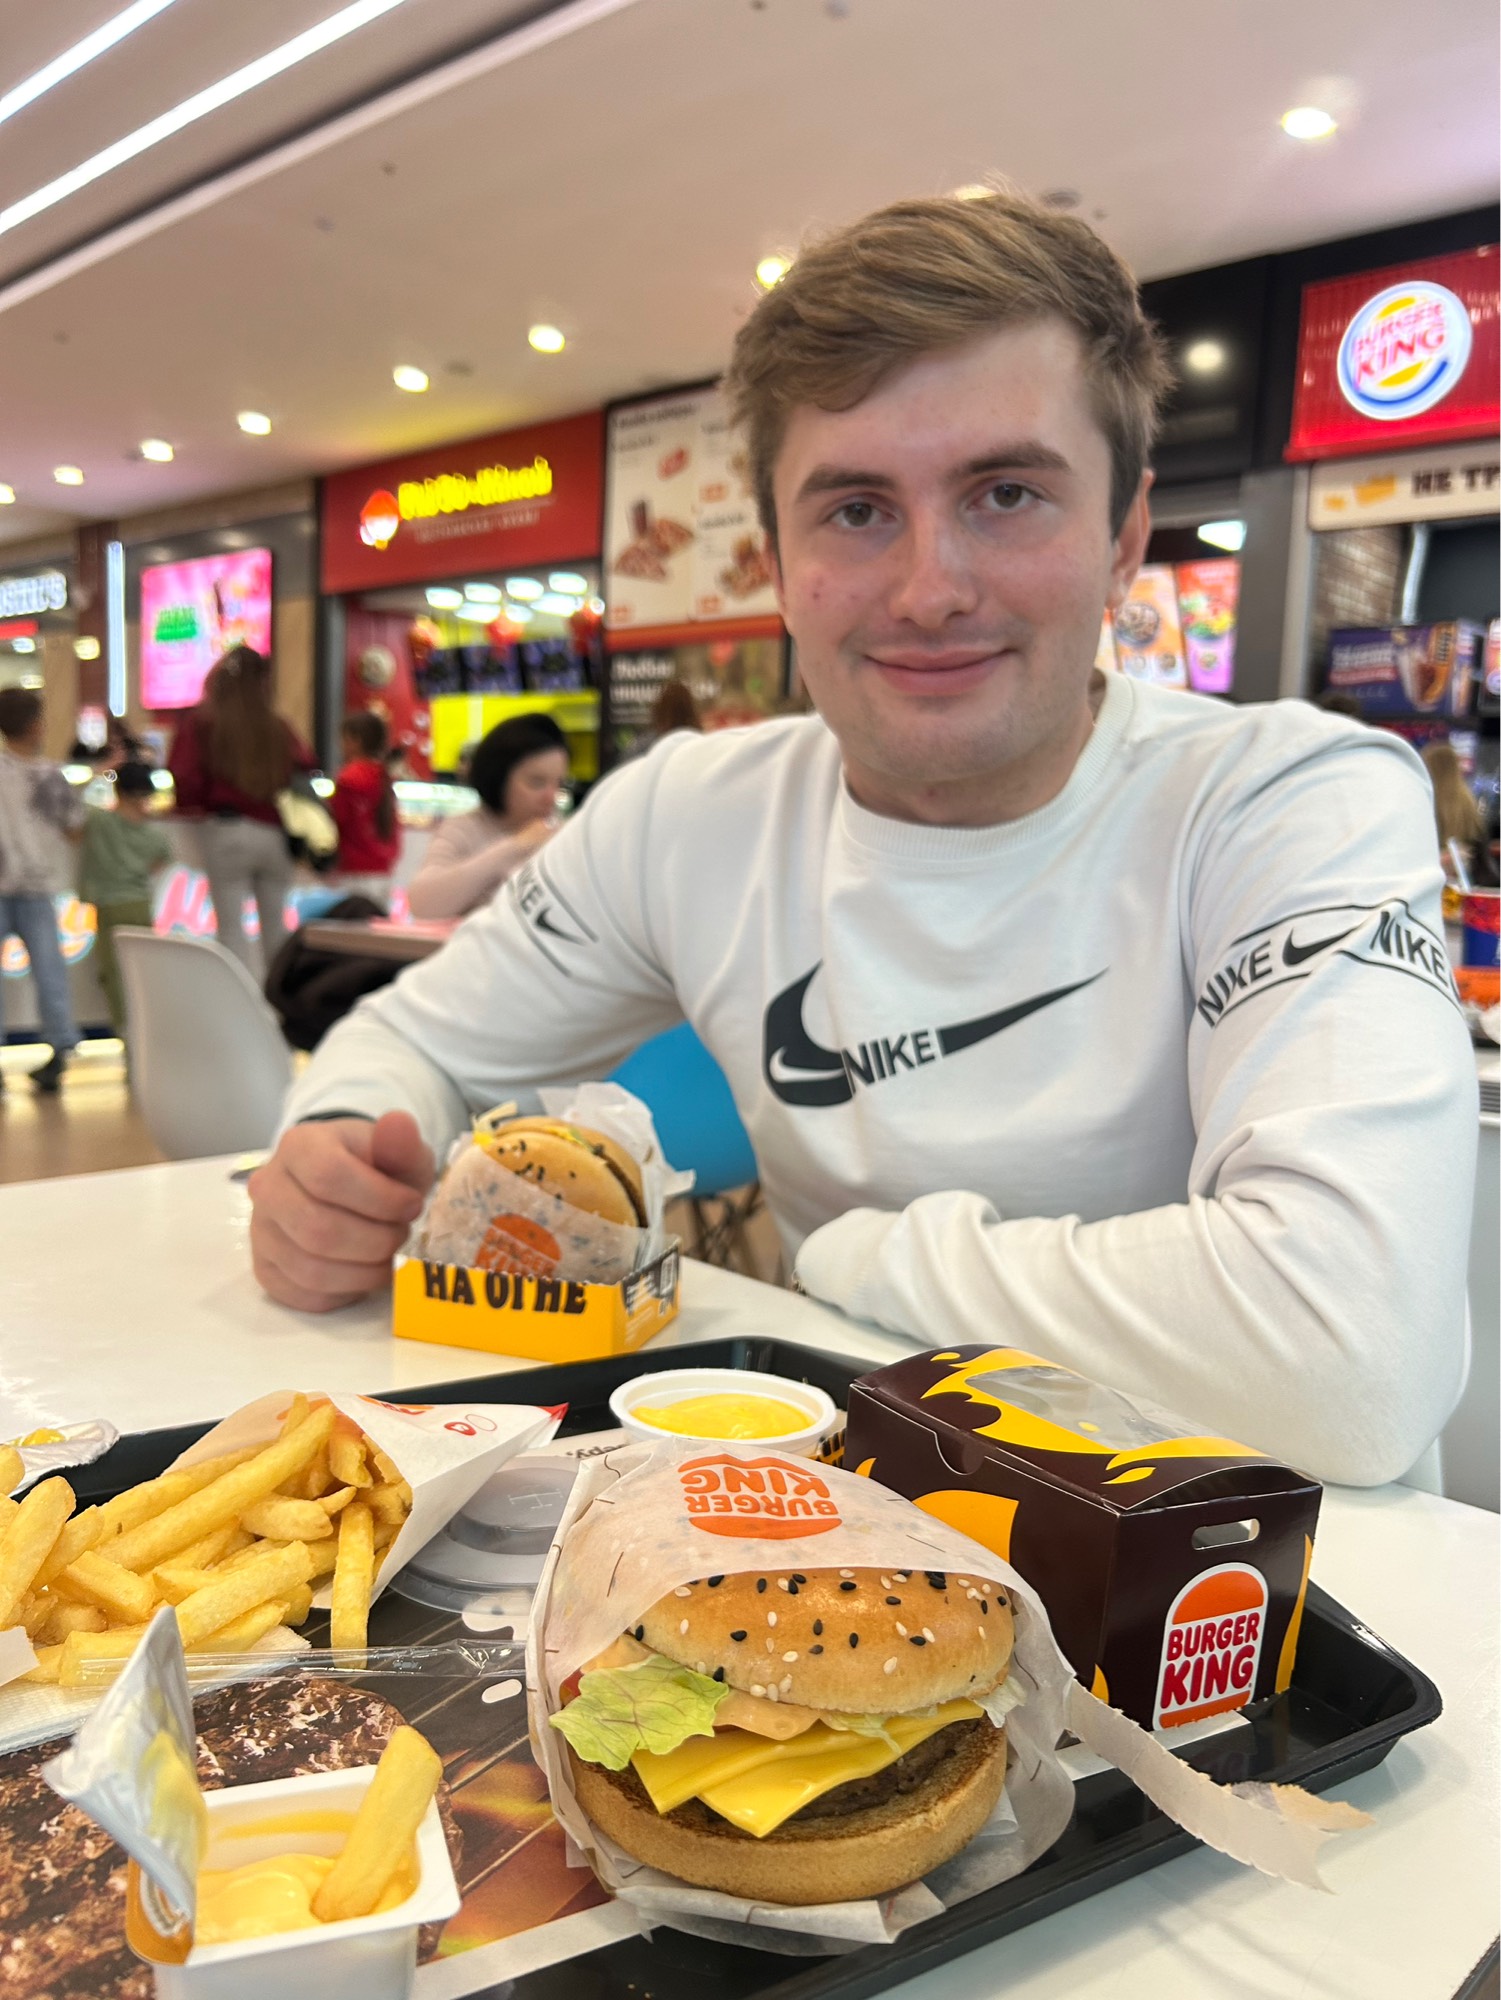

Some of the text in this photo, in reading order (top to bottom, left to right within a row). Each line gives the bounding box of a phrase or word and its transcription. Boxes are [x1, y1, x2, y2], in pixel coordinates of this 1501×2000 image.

[1355, 302, 1445, 354] BURGER
[1355, 324, 1446, 386] KING
[1370, 911, 1449, 988] NIKE
[1198, 940, 1273, 1029] NIKE
[842, 1030, 937, 1095] NIKE
[680, 1467, 830, 1498] KING
[685, 1495, 839, 1517] BURGER
[1167, 1612, 1260, 1661] BURGER
[1160, 1645, 1255, 1709] KING
